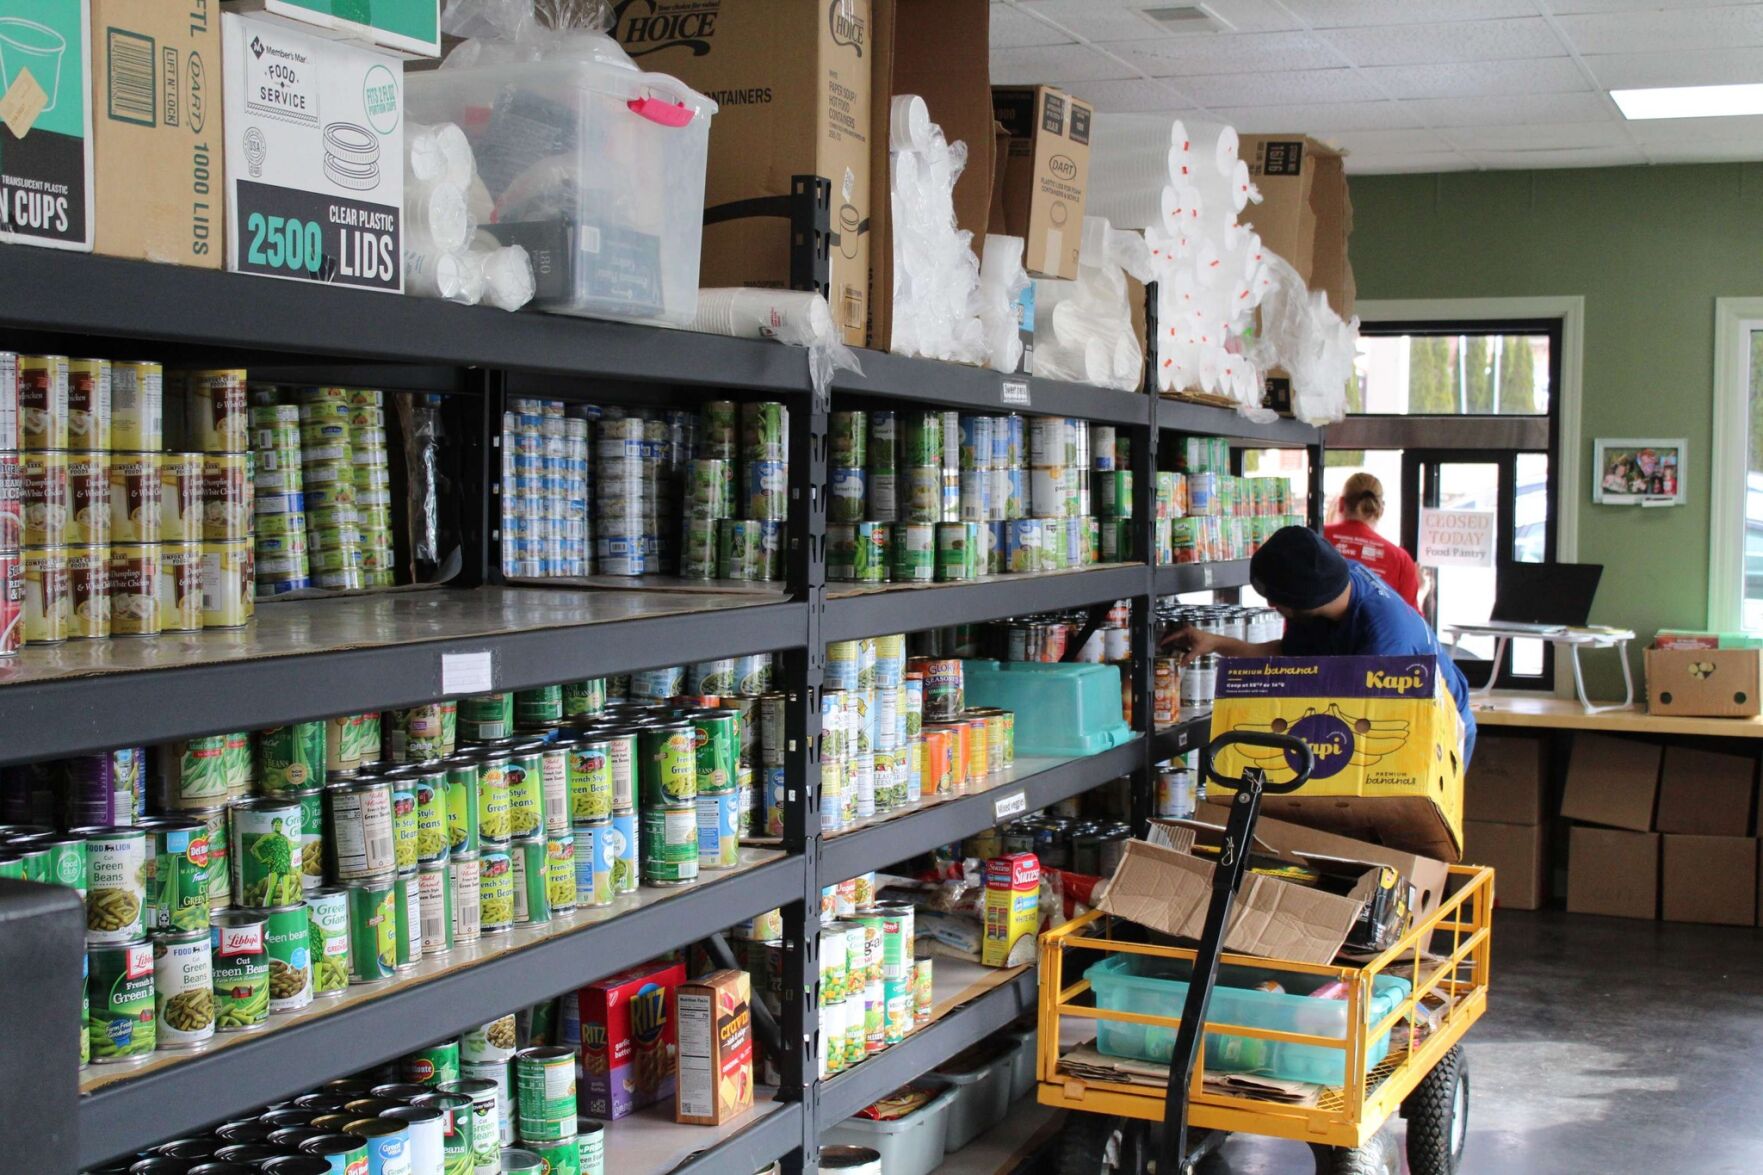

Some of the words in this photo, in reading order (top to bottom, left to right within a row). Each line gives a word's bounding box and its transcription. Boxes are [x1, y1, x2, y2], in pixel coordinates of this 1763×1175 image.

[266, 46, 294, 61] Member's
[269, 64, 296, 84] FOOD
[190, 60, 201, 124] DART
[260, 86, 306, 110] SERVICE
[167, 94, 176, 122] LOCK
[193, 142, 210, 195] 1000
[1052, 159, 1074, 176] DART
[1, 174, 43, 191] TRANSLUCENT
[44, 182, 69, 195] PLASTIC
[15, 189, 69, 233] CUPS
[329, 204, 358, 226] CLEAR
[359, 210, 394, 232] PLASTIC
[192, 202, 209, 255] LIDS
[248, 212, 322, 272] 2500
[340, 228, 394, 282] LIDS
[1425, 513, 1489, 529] CLOSED
[1428, 530, 1484, 545] TODAY
[1425, 547, 1449, 557] Food
[1453, 548, 1487, 559] Pantry
[1264, 664, 1319, 675] bananas
[1365, 670, 1424, 695] Kapi
[1366, 774, 1416, 785] bananas
[93, 861, 123, 871] Green
[93, 872, 124, 882] Beans
[316, 903, 345, 915] Green
[228, 932, 258, 948] Libby's
[173, 947, 192, 957] FOOD
[182, 962, 207, 974] Green
[236, 957, 250, 966] Cut
[126, 979, 150, 991] French
[183, 973, 208, 985] Beans
[113, 989, 147, 1005] Green
[630, 987, 667, 1038] RITZ
[581, 1023, 607, 1045] RITZ
[615, 1039, 631, 1050] garlic
[614, 1048, 632, 1059] butter
[382, 1144, 401, 1152] Great
